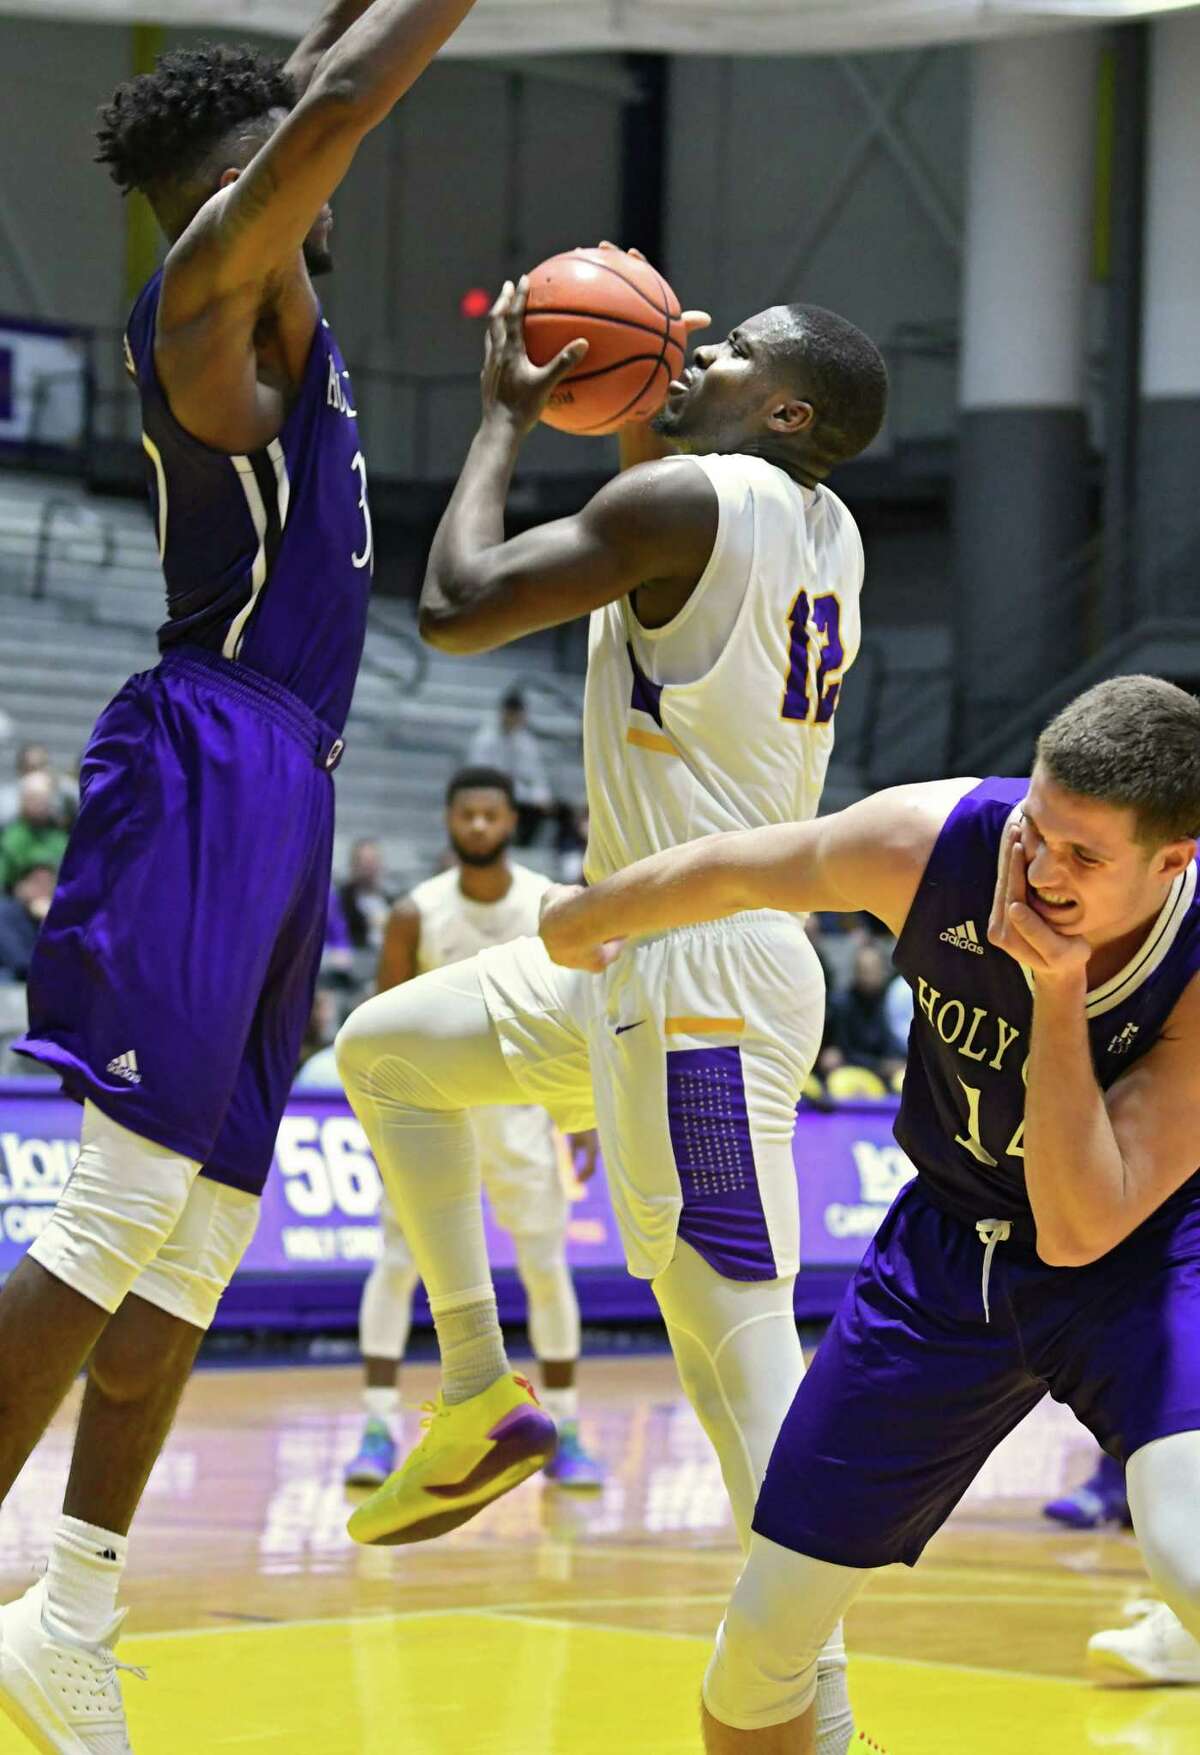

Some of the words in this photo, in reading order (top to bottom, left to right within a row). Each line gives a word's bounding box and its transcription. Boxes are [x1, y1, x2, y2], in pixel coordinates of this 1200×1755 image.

[779, 586, 845, 728] 12
[939, 931, 984, 955] adidas
[917, 976, 1019, 1071] HOLY
[276, 1116, 384, 1217] 56
